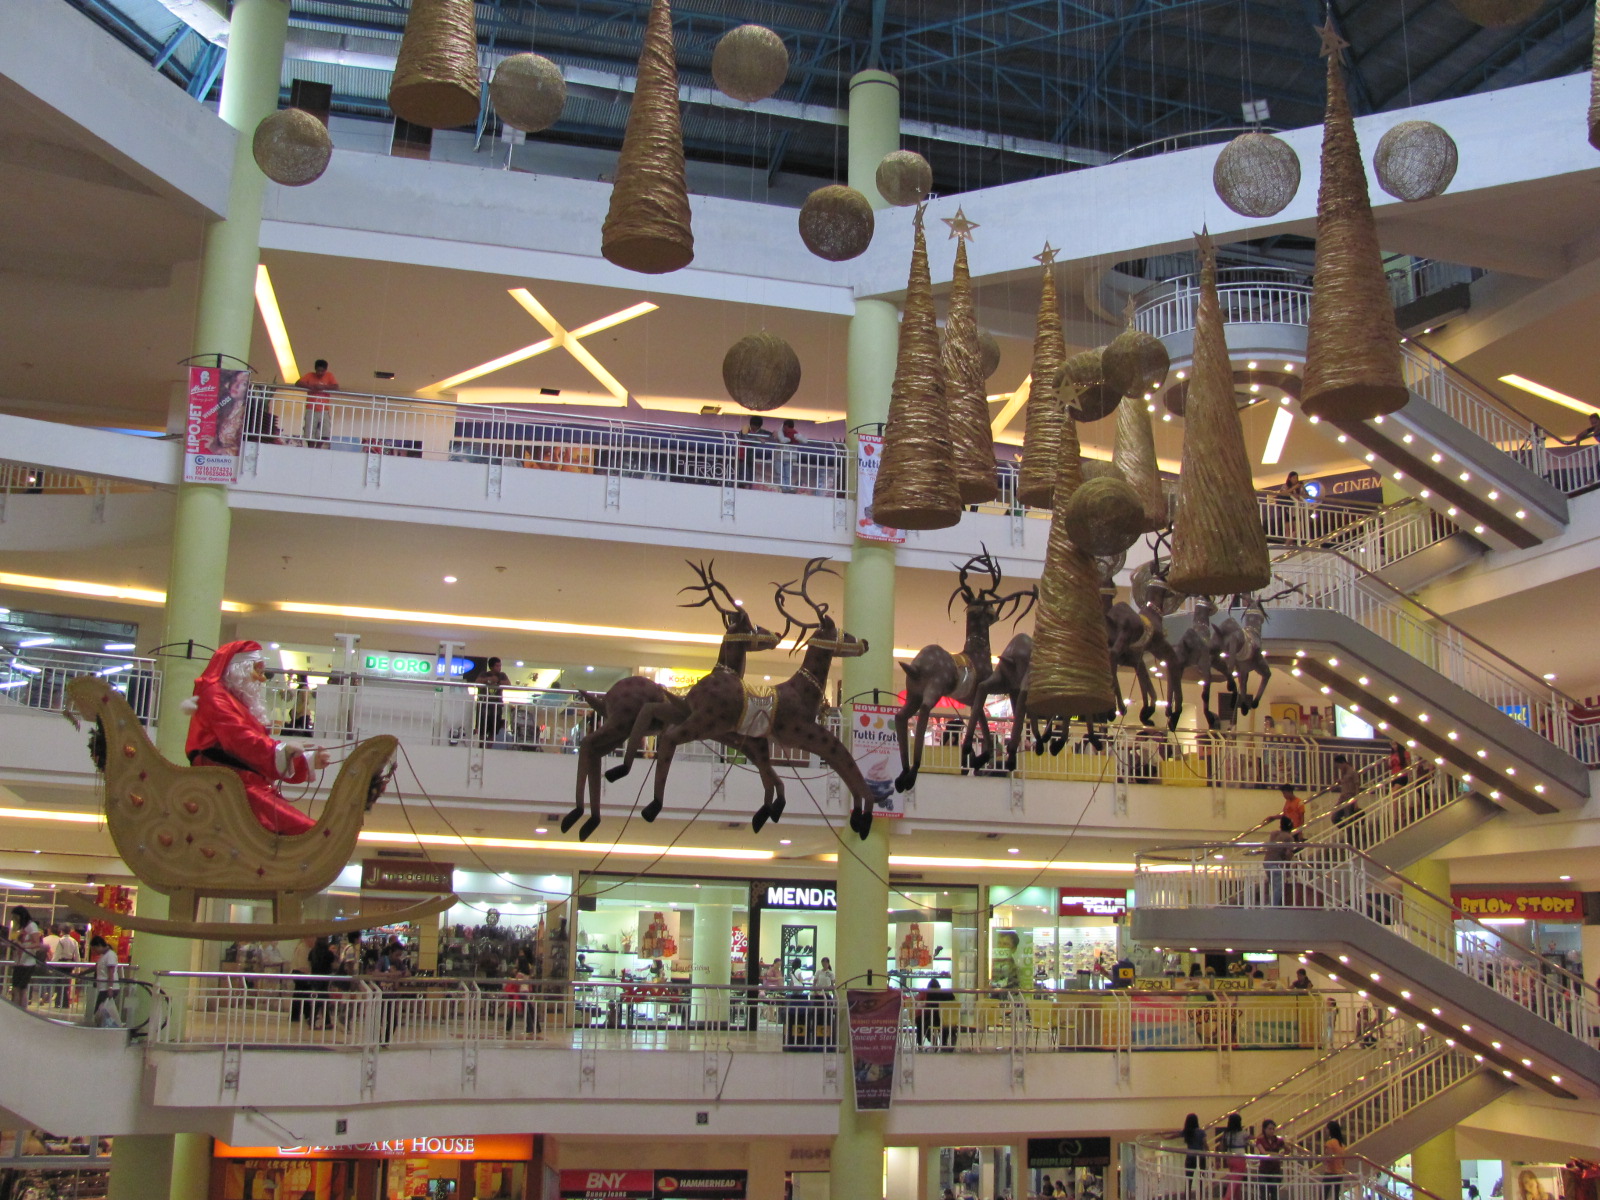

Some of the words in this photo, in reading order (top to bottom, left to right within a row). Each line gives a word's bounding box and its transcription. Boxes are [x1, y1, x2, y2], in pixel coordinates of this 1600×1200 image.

[202, 404, 220, 419] WEIGHT
[186, 404, 202, 453] LIPOJET
[859, 434, 882, 442] NOW
[858, 458, 880, 468] Tutti
[366, 656, 389, 670] DE
[393, 658, 431, 673] ORO
[668, 675, 695, 684] Kodak
[854, 730, 876, 740] Tutti
[768, 886, 837, 906] MENDR
[1062, 896, 1126, 906] SPORTS
[1083, 904, 1126, 914] TOWN
[1460, 897, 1512, 914] BELOW
[1516, 896, 1574, 913] STORE
[412, 1136, 475, 1152] HOUSE
[586, 1172, 628, 1189] BNY
[680, 1179, 736, 1188] HAMMERHEAD
